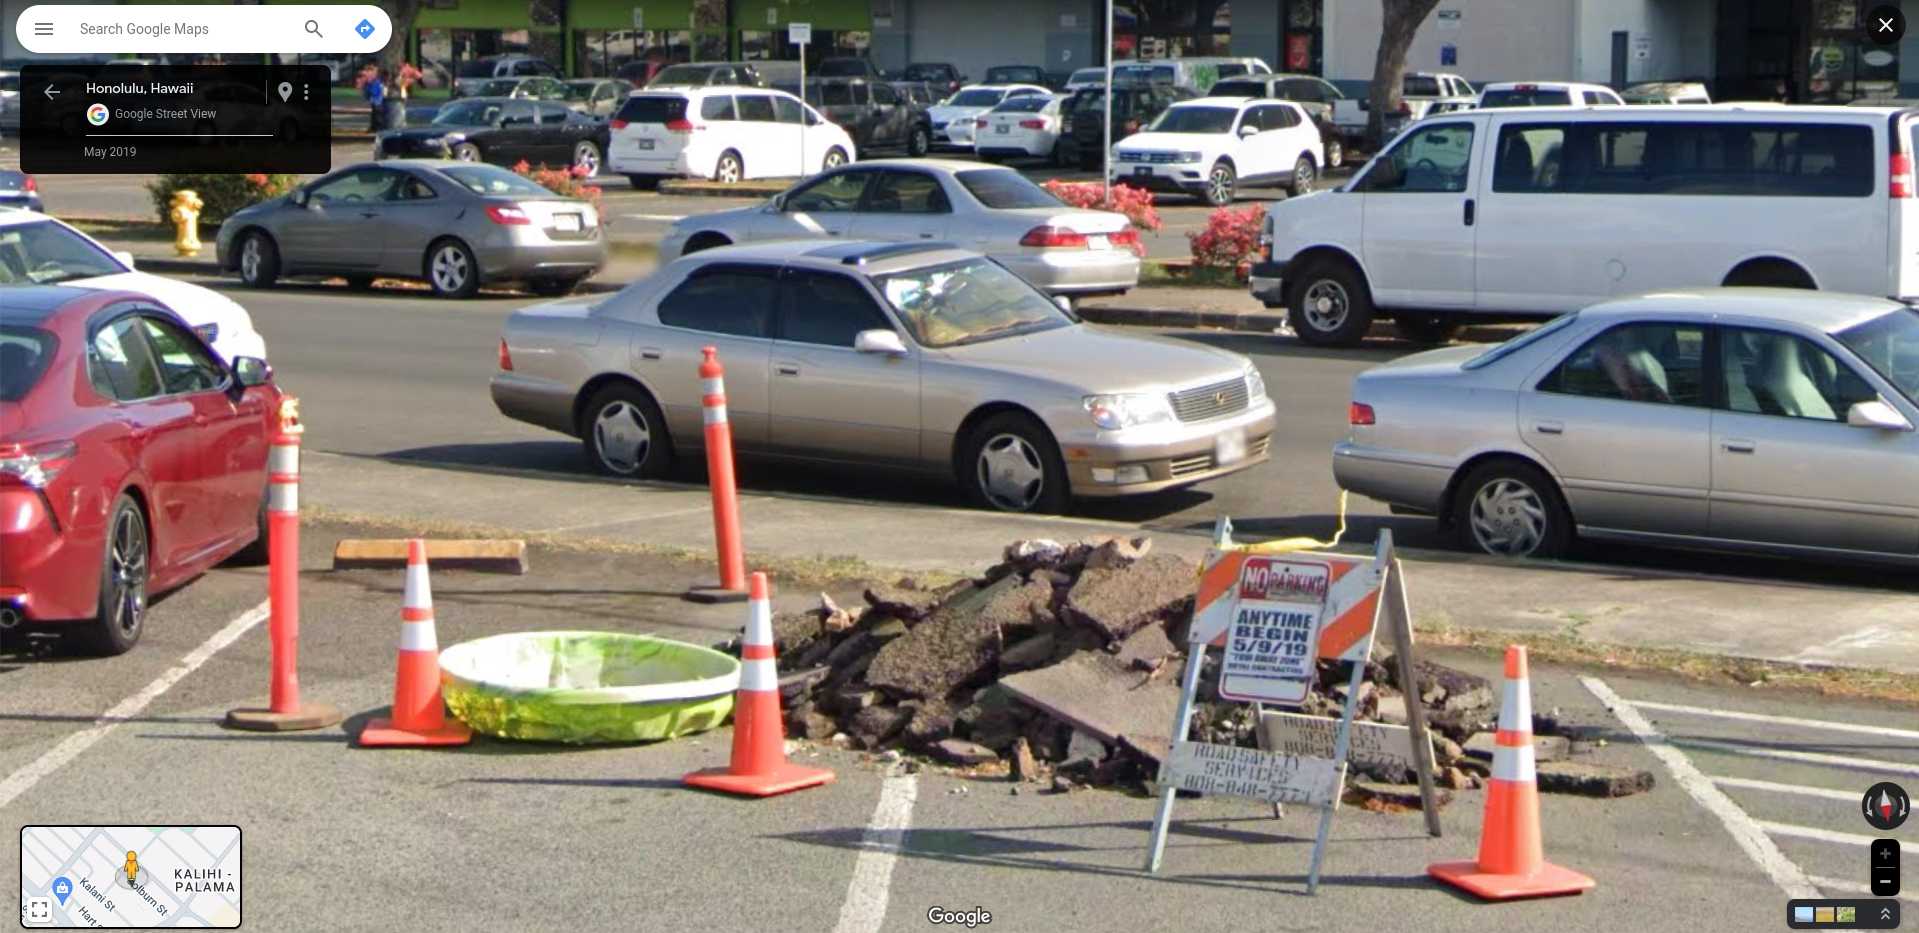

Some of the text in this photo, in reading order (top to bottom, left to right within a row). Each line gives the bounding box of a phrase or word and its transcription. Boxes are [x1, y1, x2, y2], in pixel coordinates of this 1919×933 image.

[1243, 565, 1325, 595] NO PARKING
[1237, 609, 1313, 630] ANYTIME
[1235, 626, 1310, 643] BEGIN
[1233, 638, 1308, 657] 5/9/19
[1194, 743, 1299, 771] ROAD SAFETY
[1204, 761, 1289, 785] SERVICES
